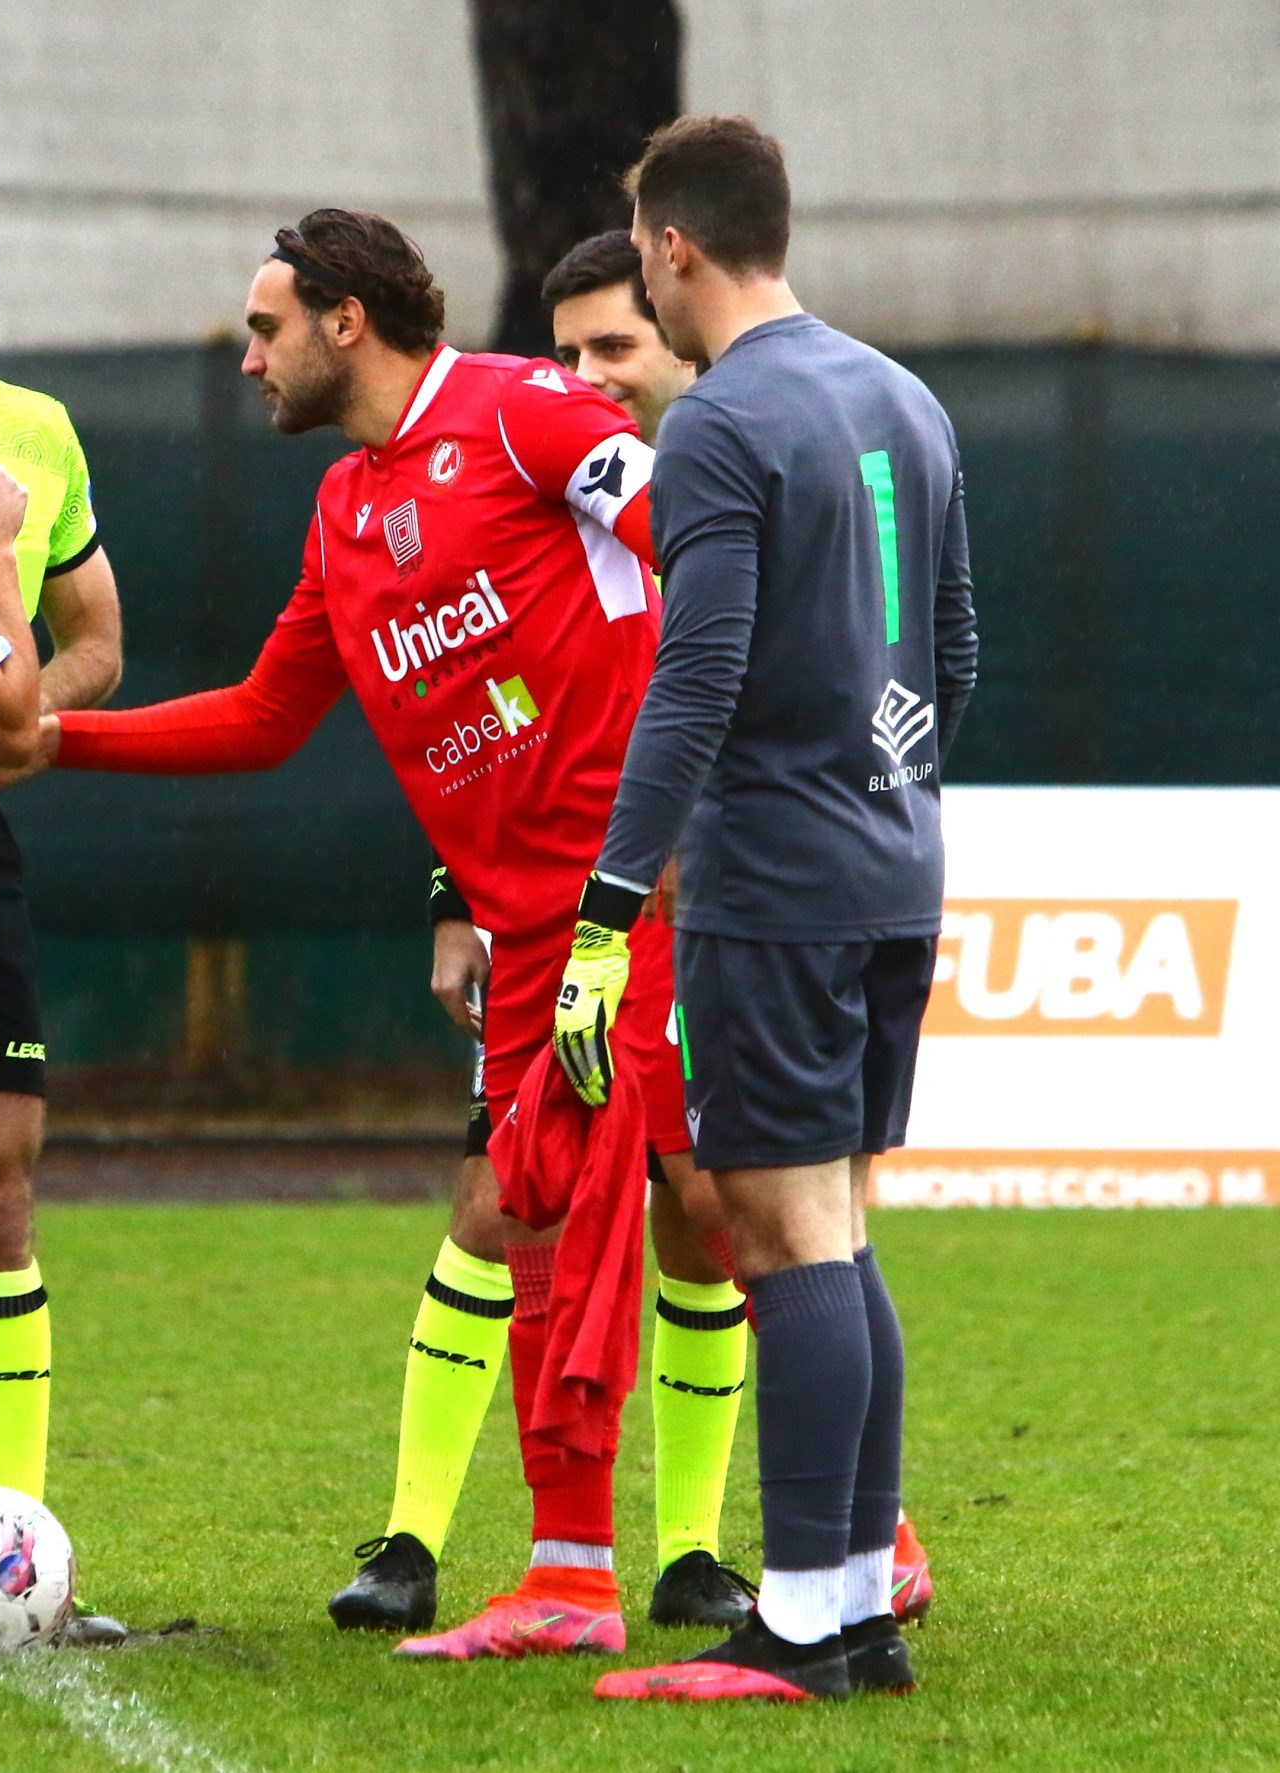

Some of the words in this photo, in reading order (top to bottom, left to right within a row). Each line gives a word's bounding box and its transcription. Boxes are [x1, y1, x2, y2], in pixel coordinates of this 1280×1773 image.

[859, 450, 900, 645] 1
[371, 569, 509, 682] Unical
[426, 677, 533, 774] cabek
[439, 761, 493, 797] Industry
[497, 730, 549, 764] Experts
[876, 1166, 1210, 1208] MONTECCHIO
